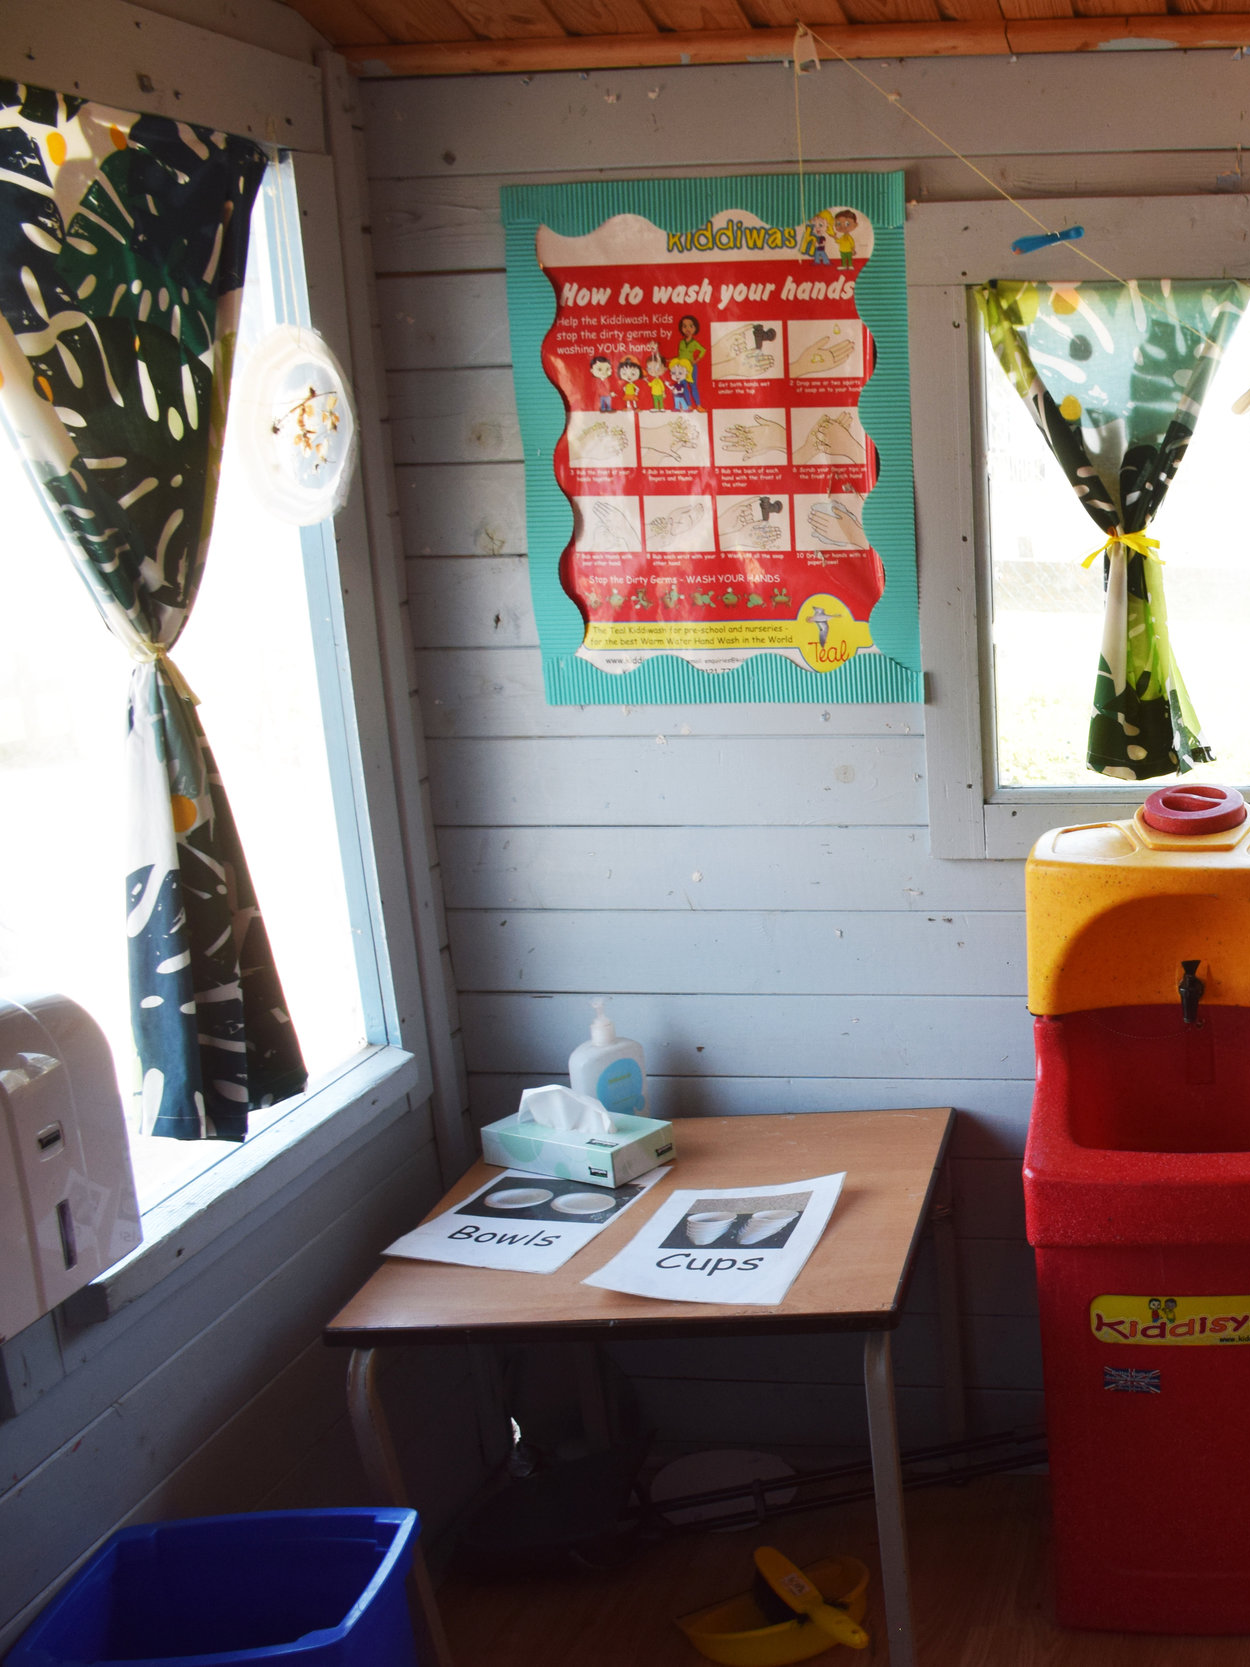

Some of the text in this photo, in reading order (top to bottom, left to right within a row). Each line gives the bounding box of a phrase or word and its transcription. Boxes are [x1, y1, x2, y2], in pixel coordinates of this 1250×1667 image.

[560, 274, 856, 311] How to wash your hands
[556, 313, 674, 328] Help the Kiddiwash Kids
[556, 328, 673, 342] stop the dirty germs by
[557, 345, 595, 356] washing
[597, 343, 626, 353] YOUR
[609, 575, 624, 584] the
[625, 575, 648, 586] Dirty
[649, 575, 677, 584] Germs
[685, 575, 716, 584] WASH
[717, 574, 745, 583] YOUR
[593, 626, 607, 634] The
[610, 626, 626, 634] Teal
[628, 626, 667, 634] Kiddiwash
[669, 626, 680, 634] for
[684, 625, 726, 635] pre-school
[728, 625, 743, 633] and
[745, 625, 783, 633] nurseries
[605, 638, 618, 646] the
[665, 637, 692, 645] Water
[694, 636, 715, 645] Hand
[717, 636, 740, 644] Wash
[742, 636, 750, 644] in
[767, 635, 793, 644] World
[807, 639, 850, 663] Teal
[447, 1225, 562, 1248] Bowls
[655, 1252, 765, 1277] Cups
